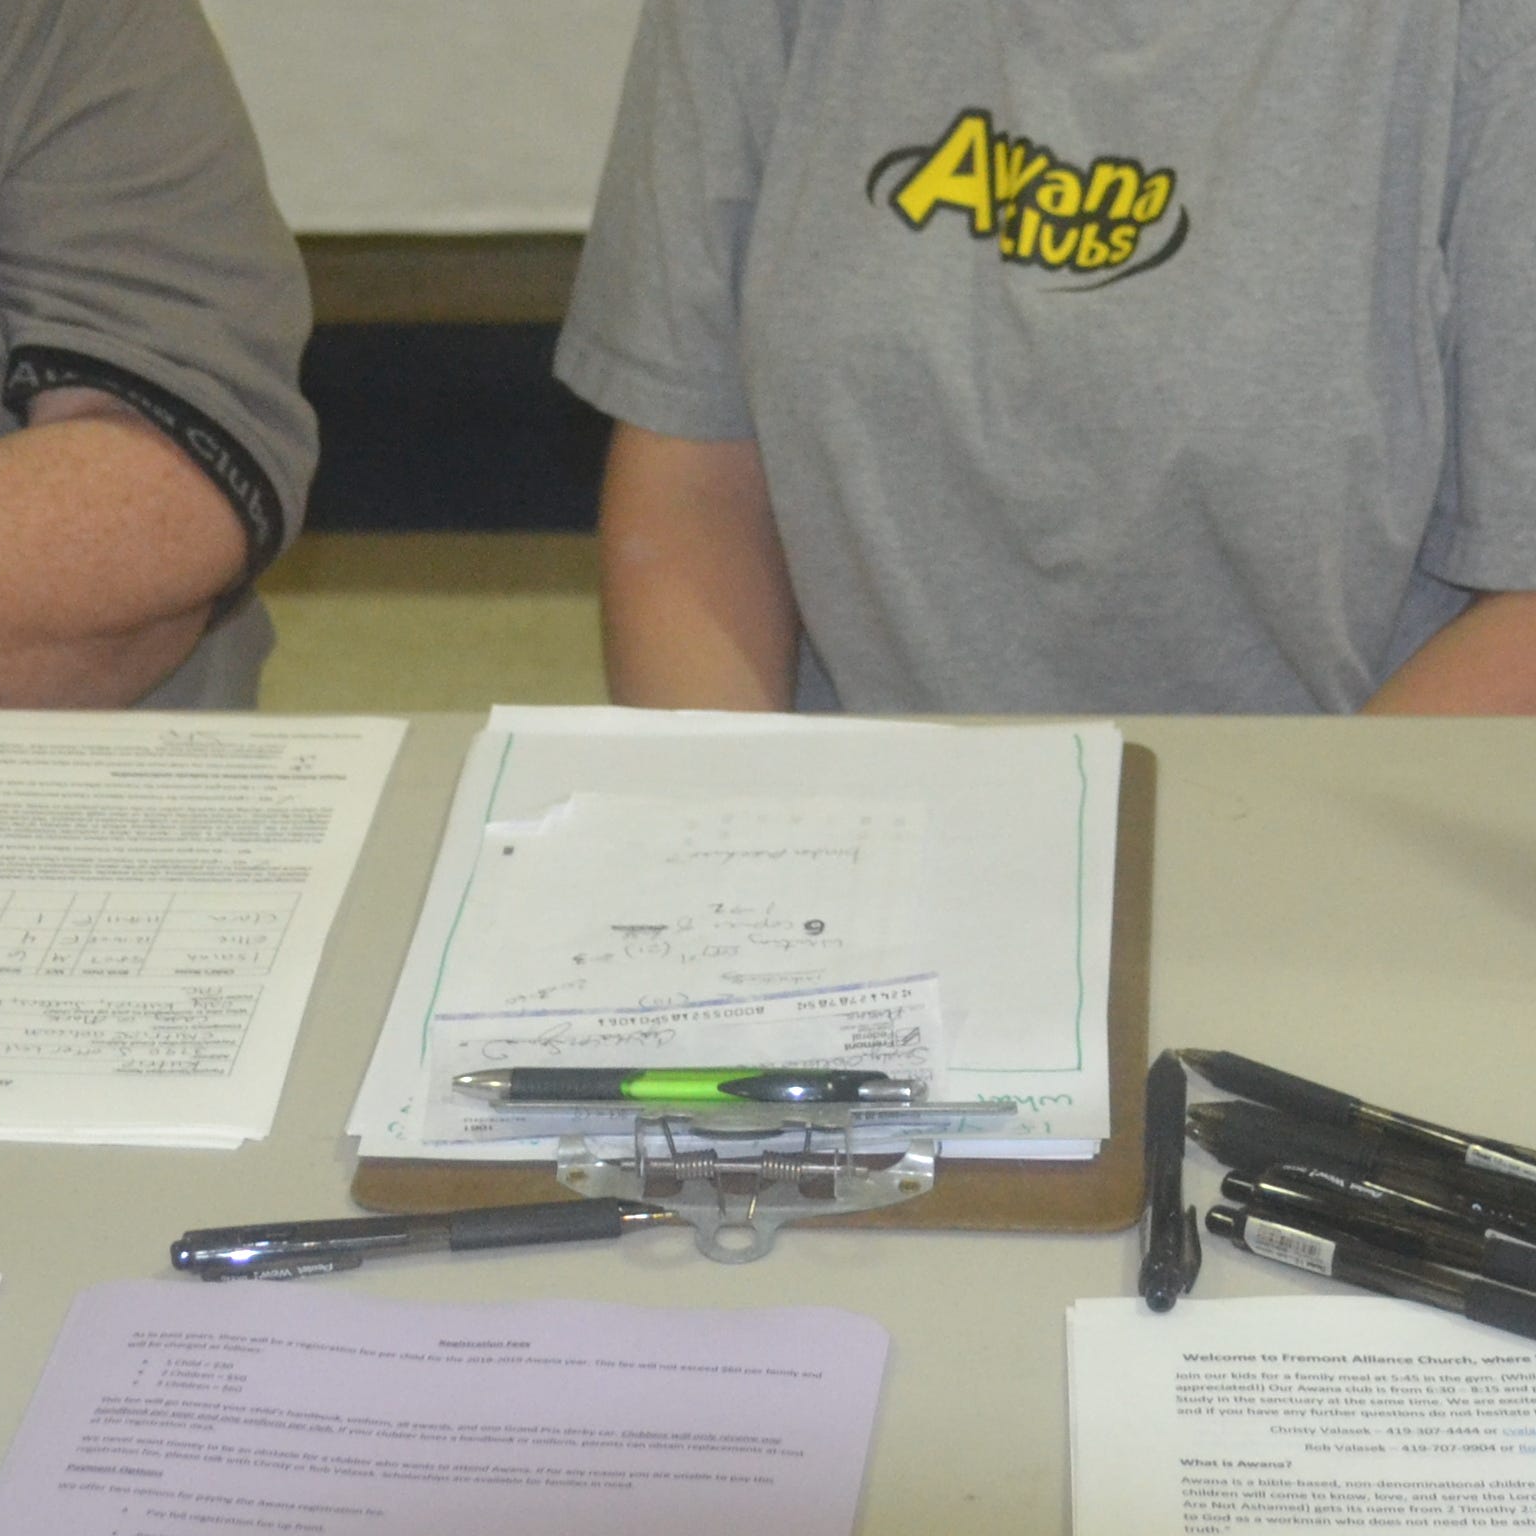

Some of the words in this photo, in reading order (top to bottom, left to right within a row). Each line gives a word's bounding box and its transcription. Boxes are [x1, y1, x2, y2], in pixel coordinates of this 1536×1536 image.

[1183, 1353, 1256, 1362] Welcome
[1262, 1353, 1277, 1363] to
[1282, 1353, 1347, 1364] Fremont
[1352, 1354, 1413, 1365] Alliance
[1418, 1355, 1477, 1366] Church,
[1482, 1355, 1531, 1364] where
[1176, 1372, 1200, 1381] Join
[1205, 1373, 1226, 1381] our
[1231, 1372, 1256, 1381] kids
[1261, 1372, 1279, 1381] for
[1295, 1372, 1334, 1383] family
[1339, 1373, 1370, 1381] meal
[1391, 1373, 1419, 1382] 5:45
[1423, 1374, 1435, 1382] in
[1440, 1373, 1461, 1382] the
[1269, 1384, 1292, 1393] Our
[1298, 1384, 1341, 1394] Awana
[1345, 1385, 1372, 1394] club
[1377, 1385, 1386, 1394] is
[1391, 1385, 1422, 1394] from
[1426, 1386, 1455, 1394] 6:30
[1471, 1385, 1499, 1394] 8:15
[1504, 1384, 1528, 1393] and
[1176, 1395, 1213, 1405] Study
[1233, 1396, 1255, 1404] the
[1260, 1396, 1323, 1405] sanctuary
[1328, 1397, 1340, 1405] at
[1344, 1396, 1365, 1405] the
[1447, 1397, 1469, 1405] We
[1177, 1407, 1201, 1415] and
[1206, 1407, 1214, 1415] if
[1219, 1408, 1243, 1417] you
[1247, 1408, 1278, 1416] have
[1283, 1409, 1305, 1418] any
[1310, 1408, 1356, 1417] further
[1361, 1409, 1424, 1418] questions
[1429, 1409, 1445, 1417] do
[1450, 1409, 1472, 1417] not
[1476, 1408, 1531, 1417] hesitate
[1180, 1458, 1217, 1468] What
[1222, 1459, 1232, 1468] is
[1238, 1459, 1292, 1469] Awana?
[1181, 1477, 1228, 1486] Awana
[1233, 1478, 1242, 1486] is
[1345, 1480, 1485, 1489] non-denominational
